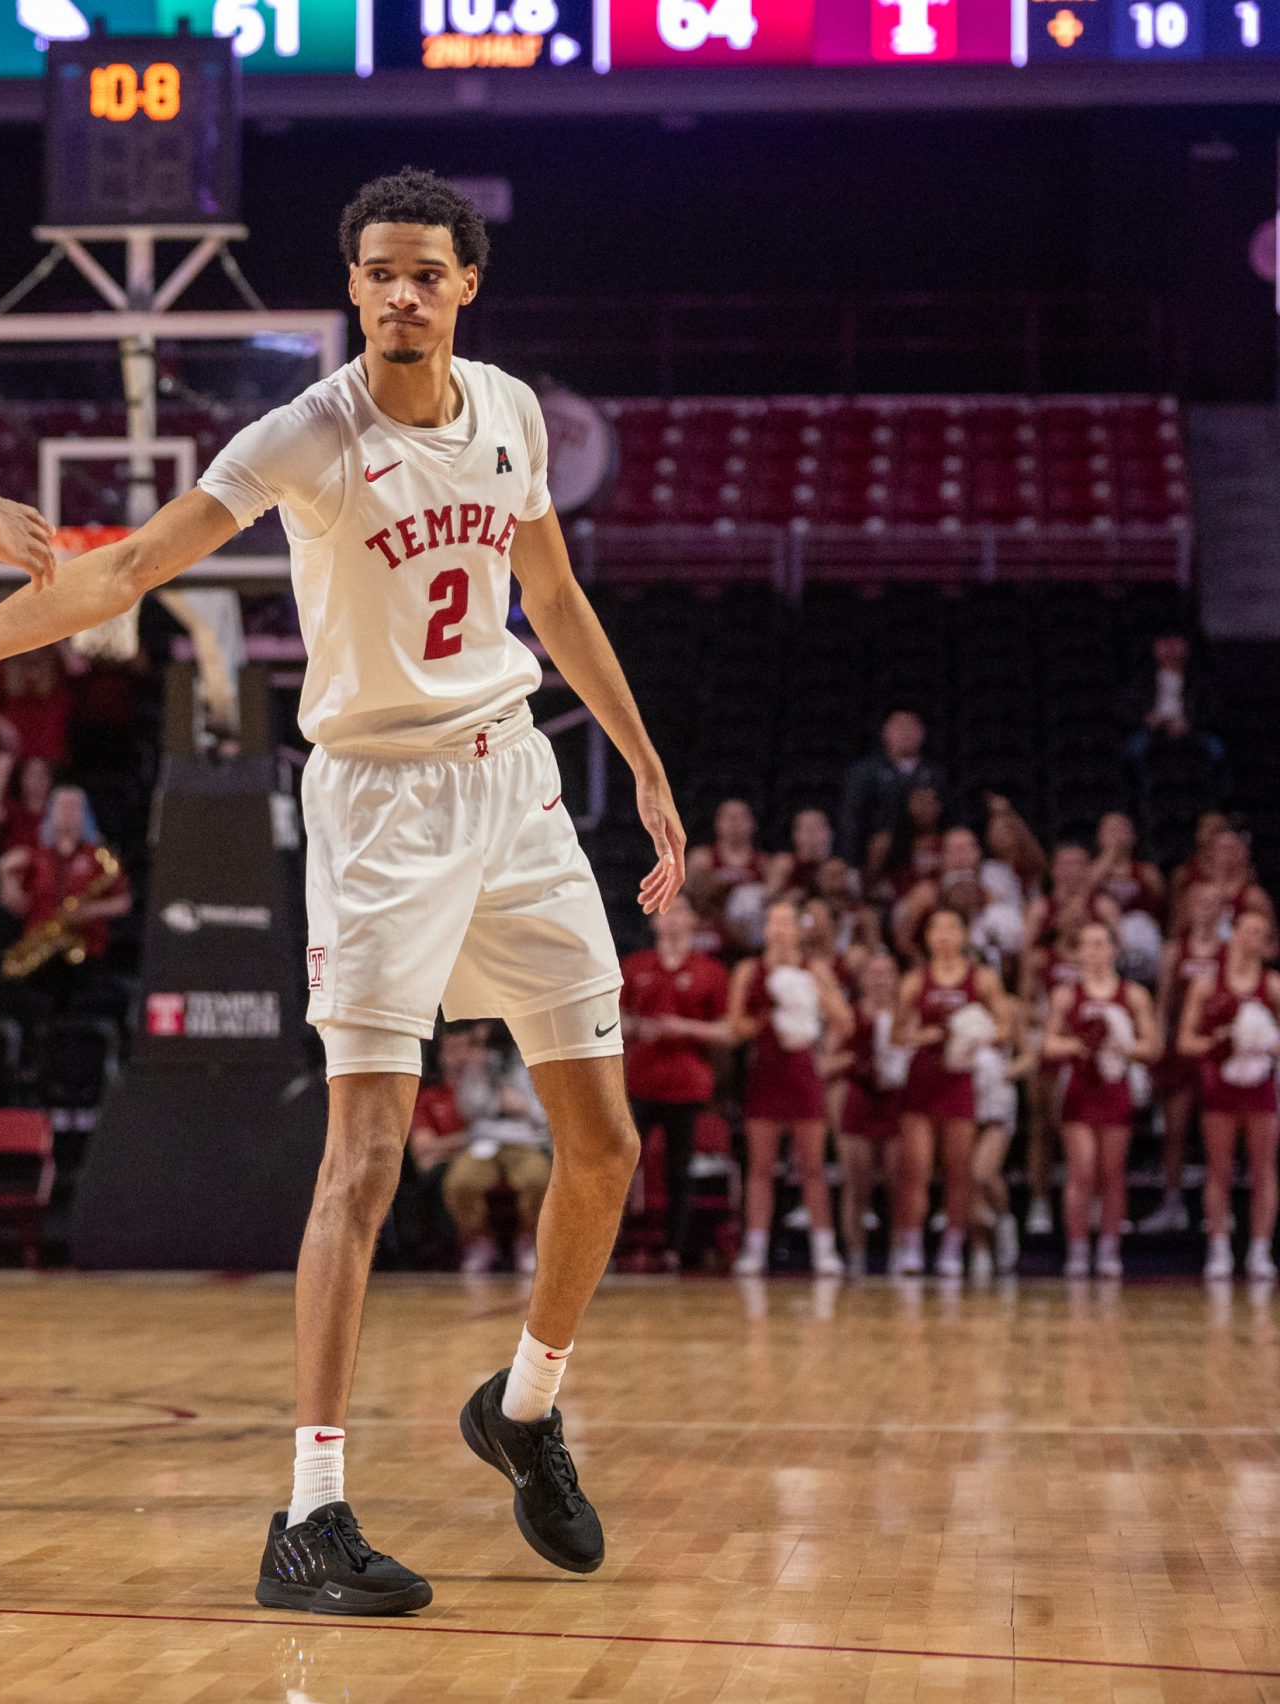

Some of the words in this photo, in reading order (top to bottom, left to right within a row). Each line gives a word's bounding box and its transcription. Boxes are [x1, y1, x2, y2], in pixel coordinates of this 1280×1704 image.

[1129, 2, 1189, 49] 10
[1234, 2, 1261, 48] 1
[365, 503, 518, 570] TEMPLE
[423, 567, 469, 660] 2
